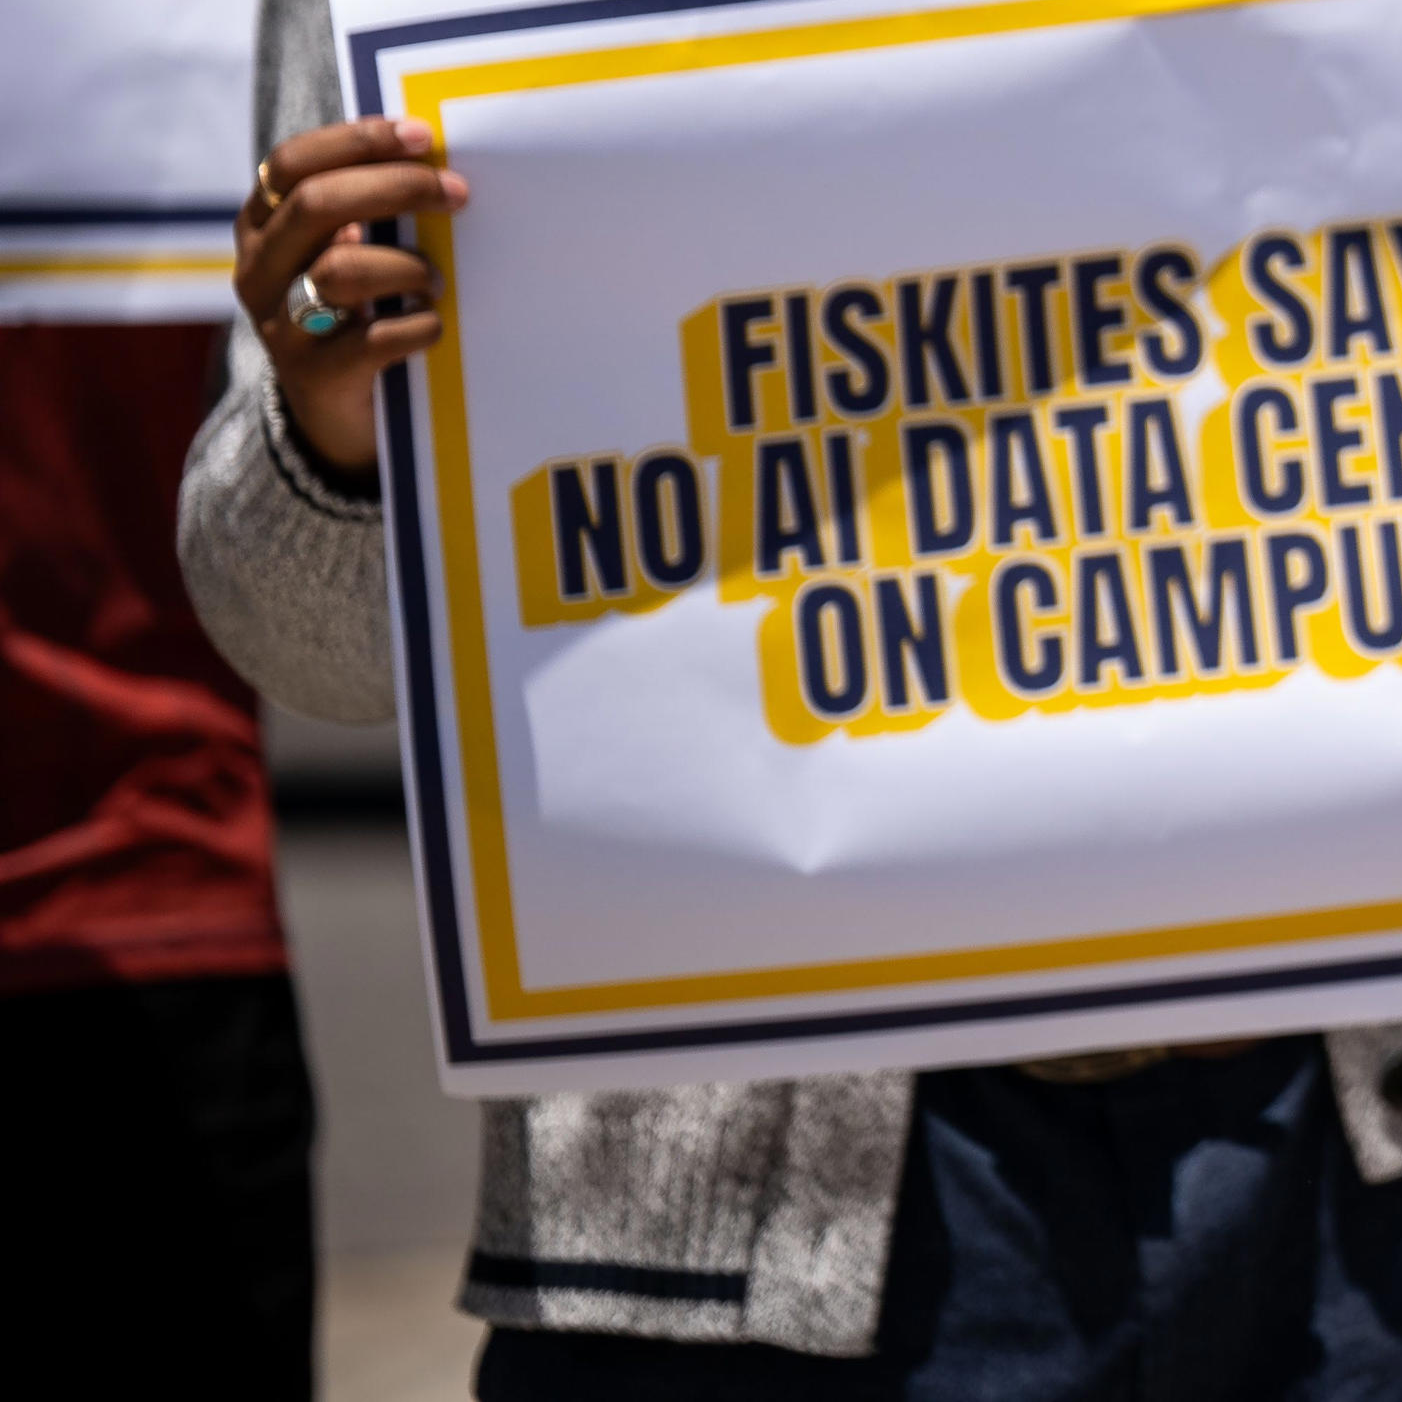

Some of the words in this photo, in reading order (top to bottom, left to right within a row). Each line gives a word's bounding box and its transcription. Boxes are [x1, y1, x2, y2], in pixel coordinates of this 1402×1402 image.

[720, 239, 1203, 434] FISKITES
[552, 451, 706, 599] NO
[755, 427, 867, 577] AI
[903, 398, 1197, 558] DATA
[799, 571, 953, 718] ON
